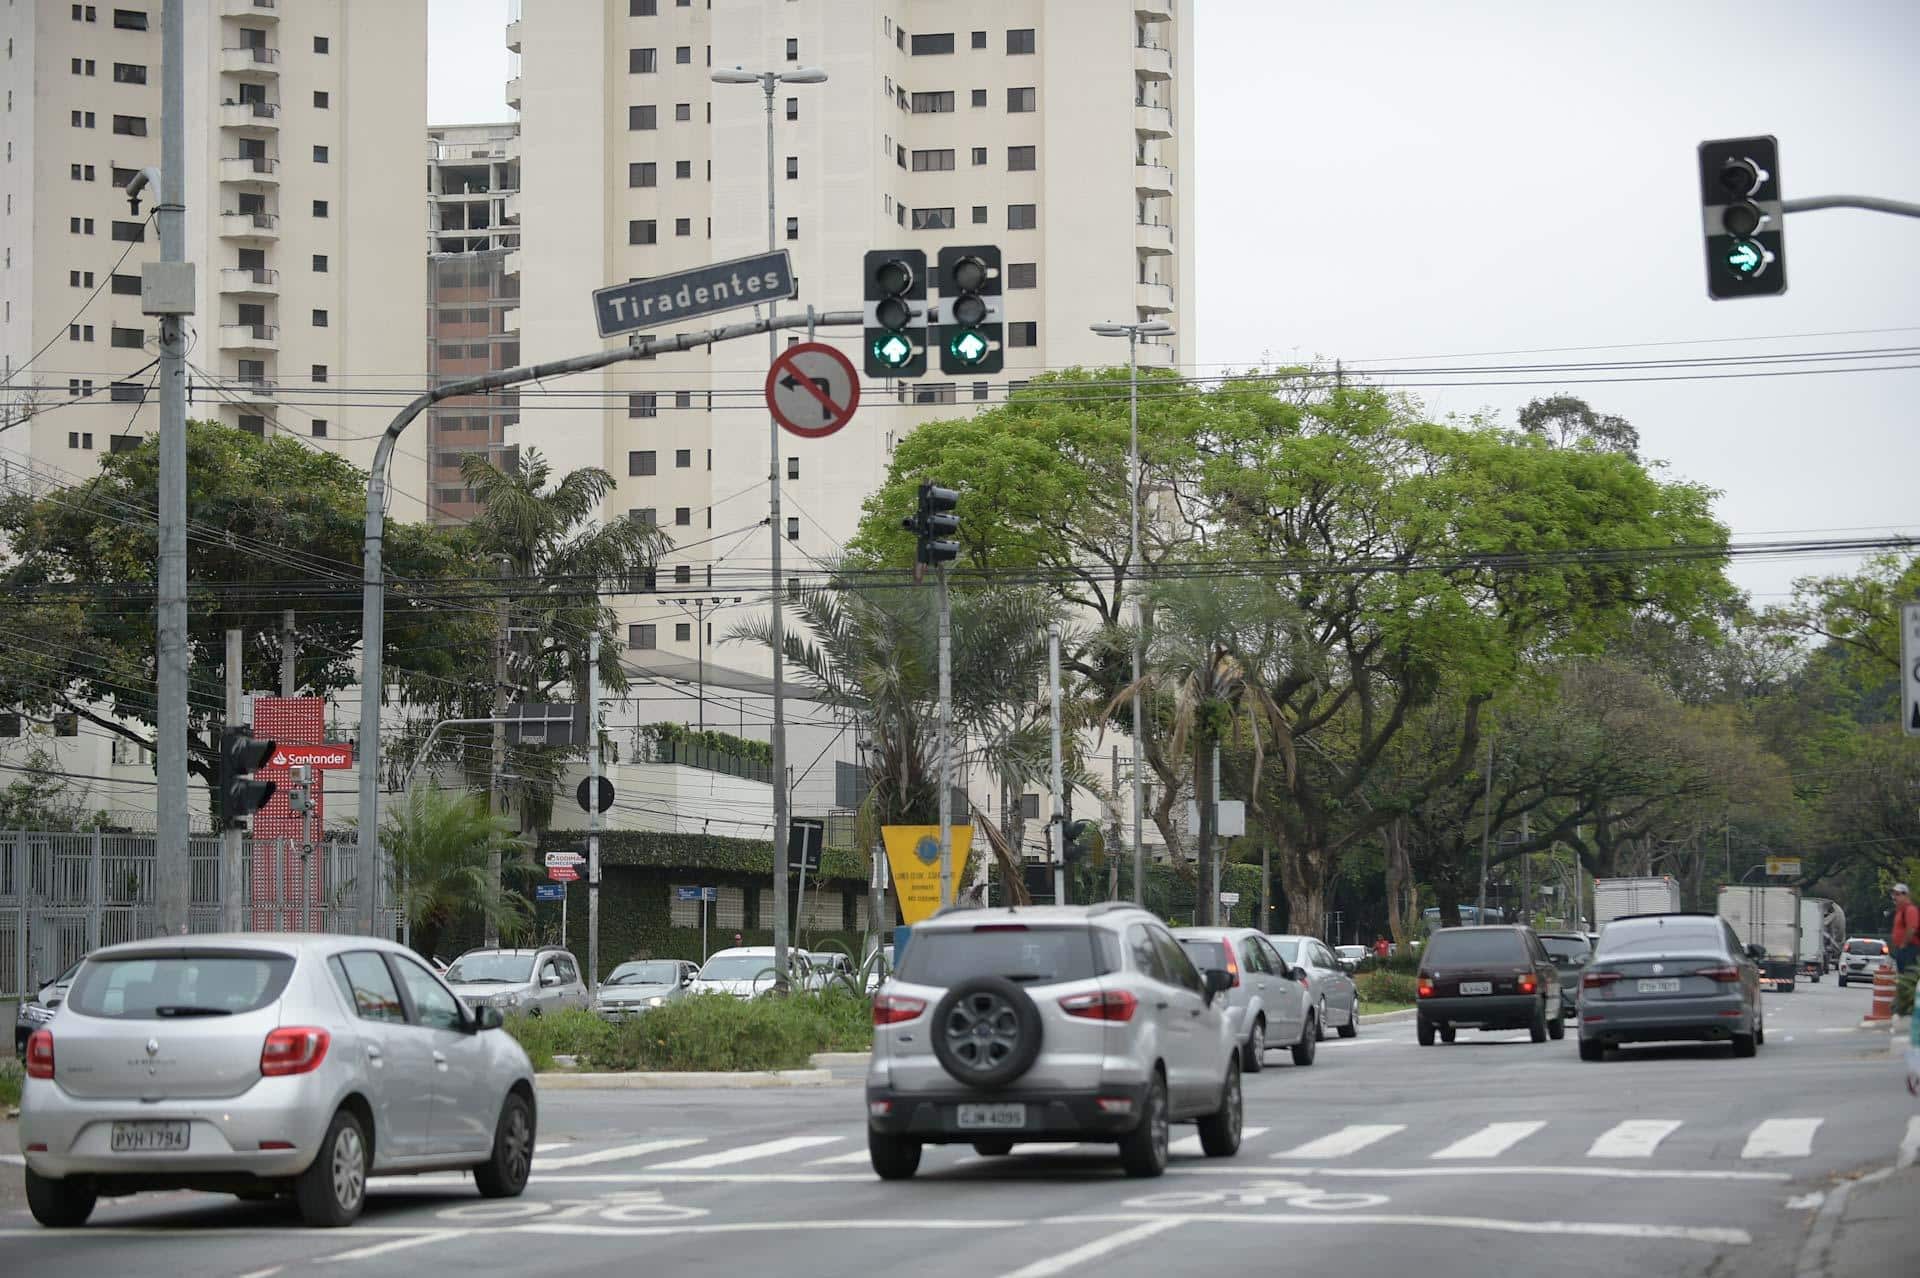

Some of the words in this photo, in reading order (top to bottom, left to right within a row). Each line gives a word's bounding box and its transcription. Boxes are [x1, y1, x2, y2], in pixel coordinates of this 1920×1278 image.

[608, 271, 780, 322] Tiradentes
[288, 753, 346, 765] Santander
[116, 1131, 144, 1147] PYH
[149, 1131, 182, 1146] 1794
